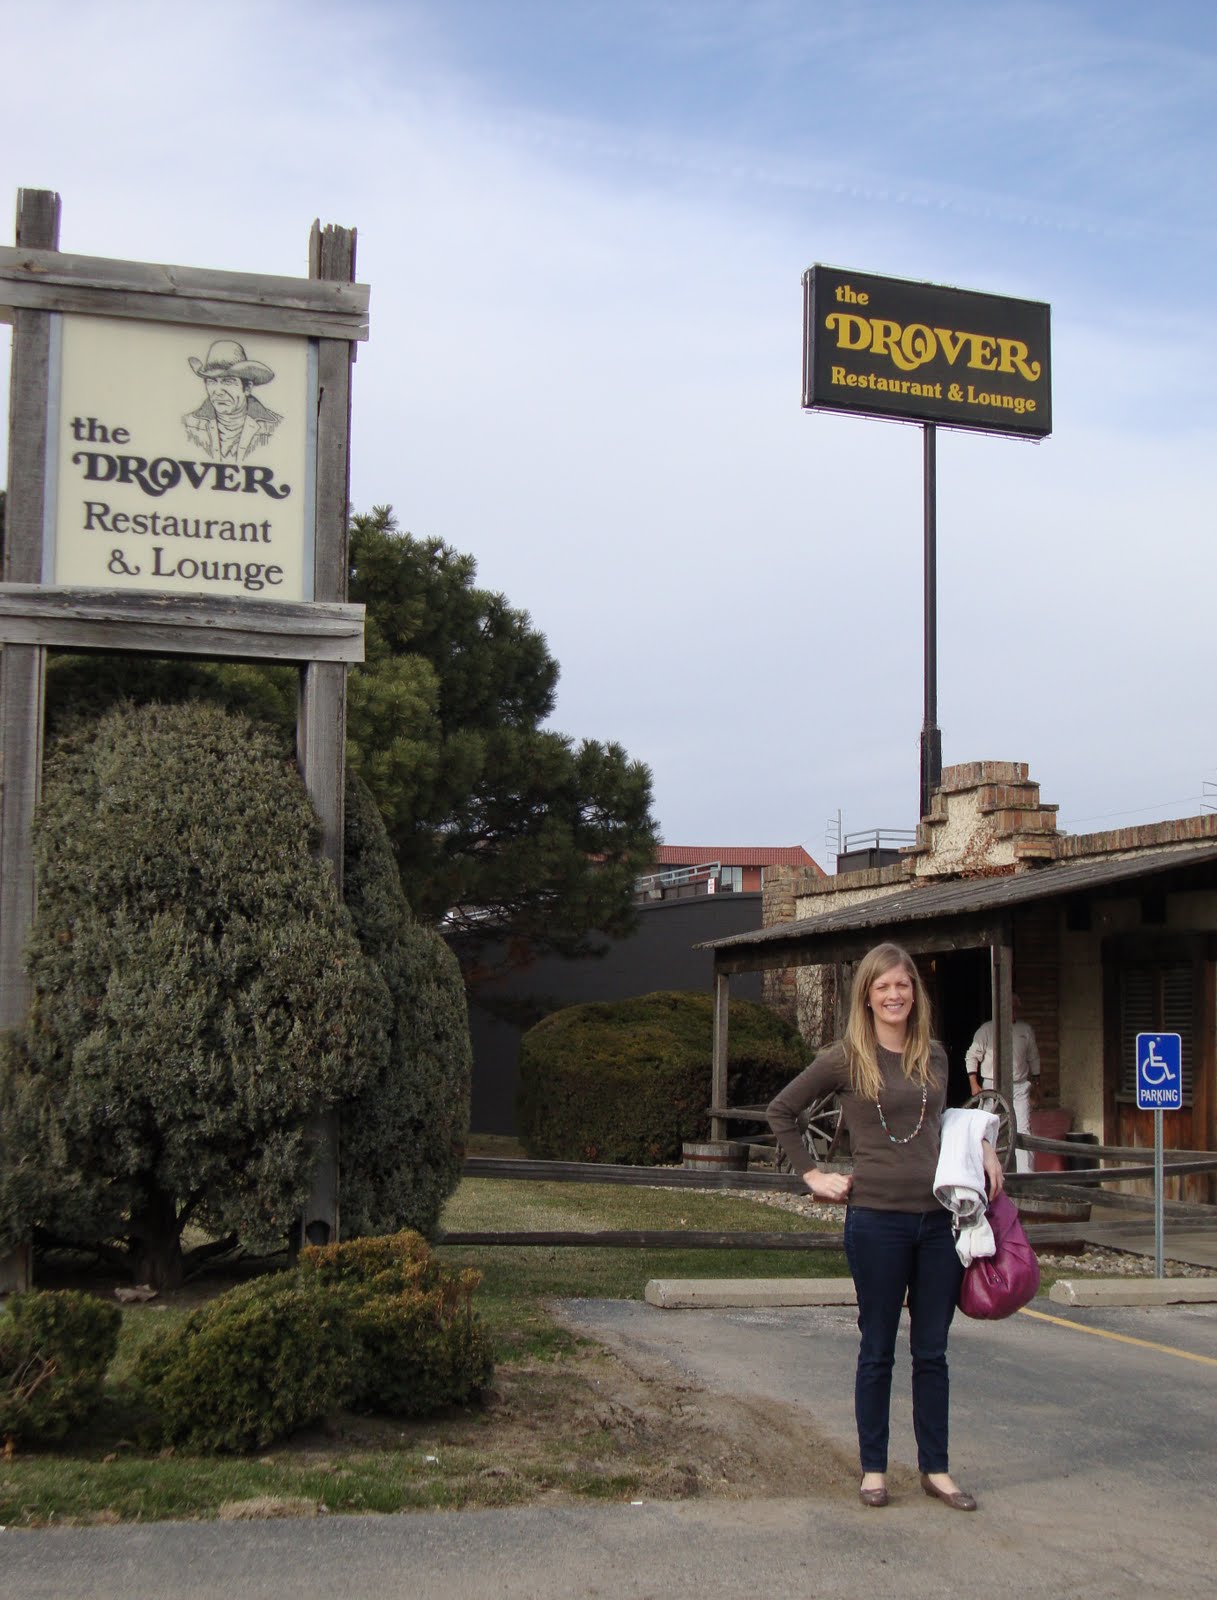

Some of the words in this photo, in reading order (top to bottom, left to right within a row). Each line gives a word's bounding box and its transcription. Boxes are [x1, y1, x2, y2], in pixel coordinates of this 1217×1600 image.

[835, 285, 869, 305] the
[825, 313, 1041, 382] DROVER
[831, 366, 942, 399] Restaurant
[947, 383, 964, 402] &
[967, 385, 1037, 414] Lounge
[70, 417, 130, 444] the
[72, 452, 291, 499] DROVER
[83, 501, 272, 543] Restaurant
[107, 549, 141, 576] &
[151, 547, 284, 591] Lounge
[1140, 1089, 1179, 1102] PARKING
